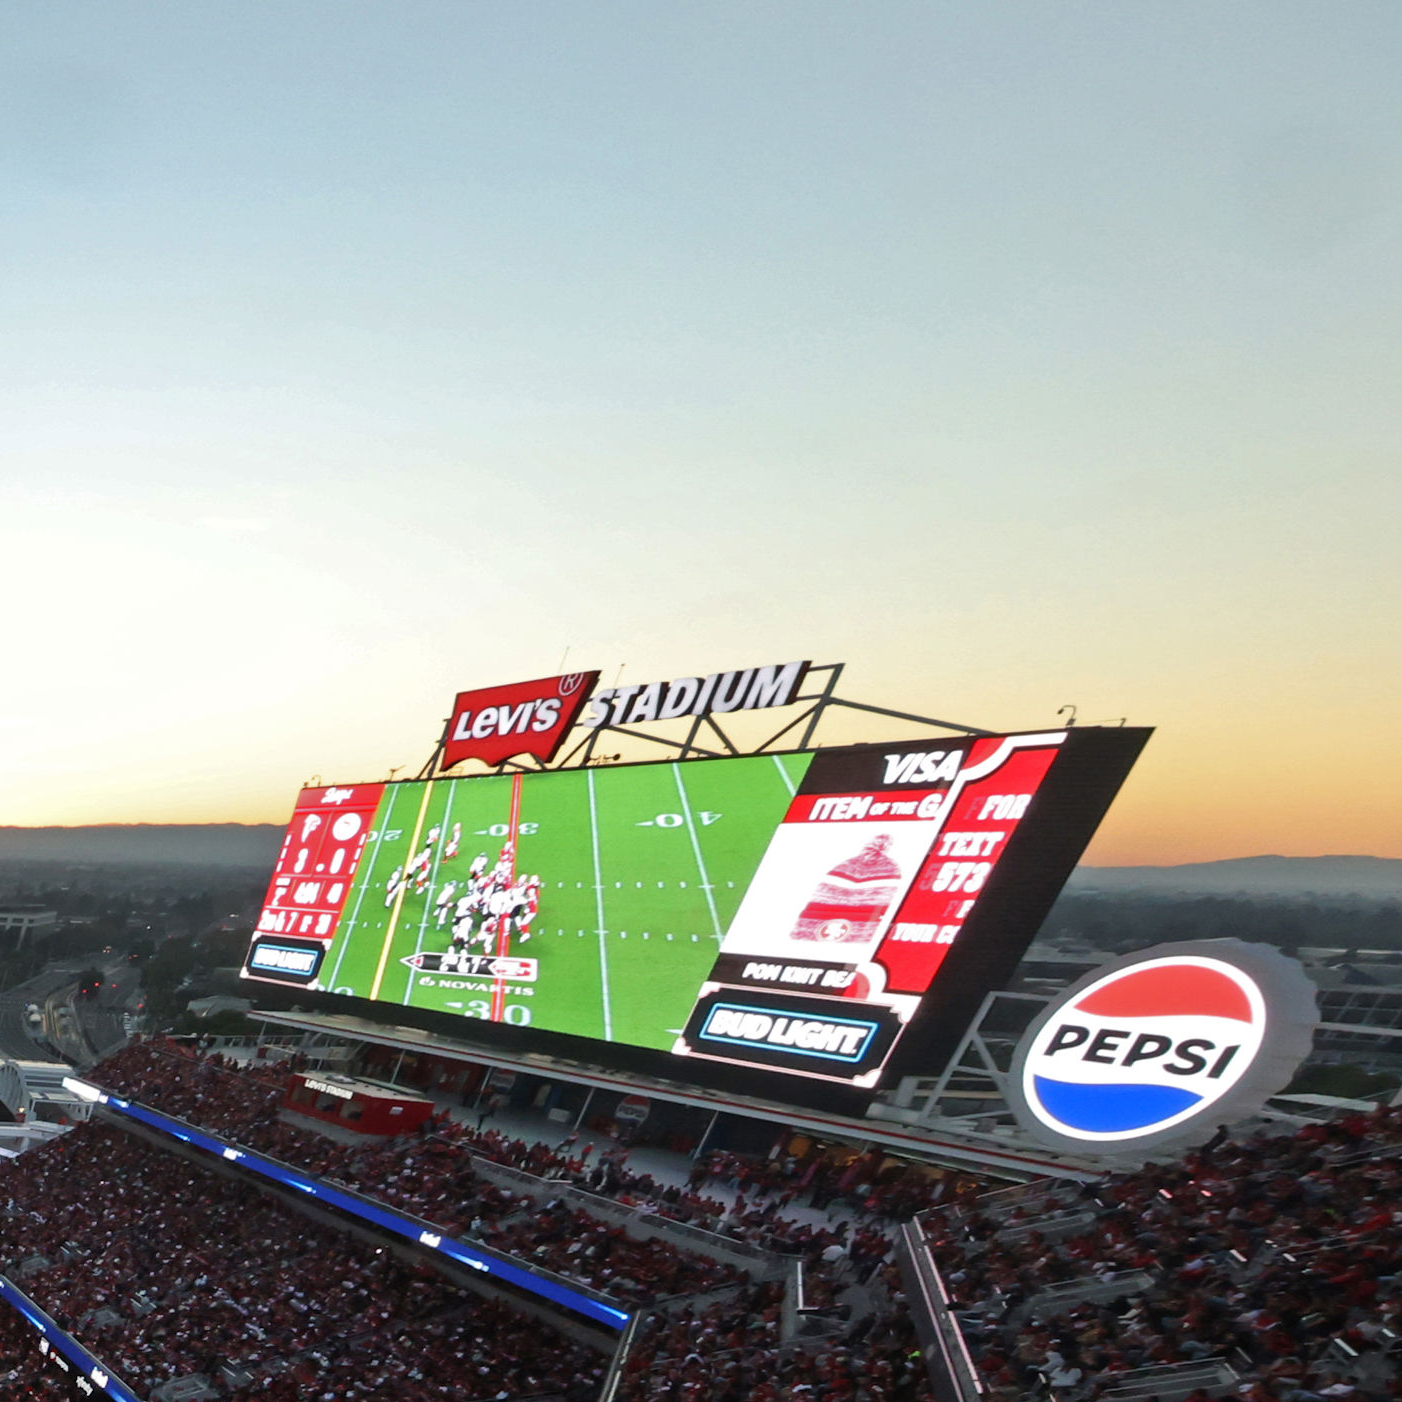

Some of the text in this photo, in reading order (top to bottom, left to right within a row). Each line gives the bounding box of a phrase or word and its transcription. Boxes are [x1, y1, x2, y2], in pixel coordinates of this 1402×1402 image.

[582, 661, 808, 728] STADIUM
[883, 750, 963, 784] VISA
[809, 796, 874, 820] ITEM
[938, 832, 1005, 857] TEXT
[707, 1009, 869, 1056] BUD LIGHT
[1044, 1024, 1242, 1079] PEPSI
